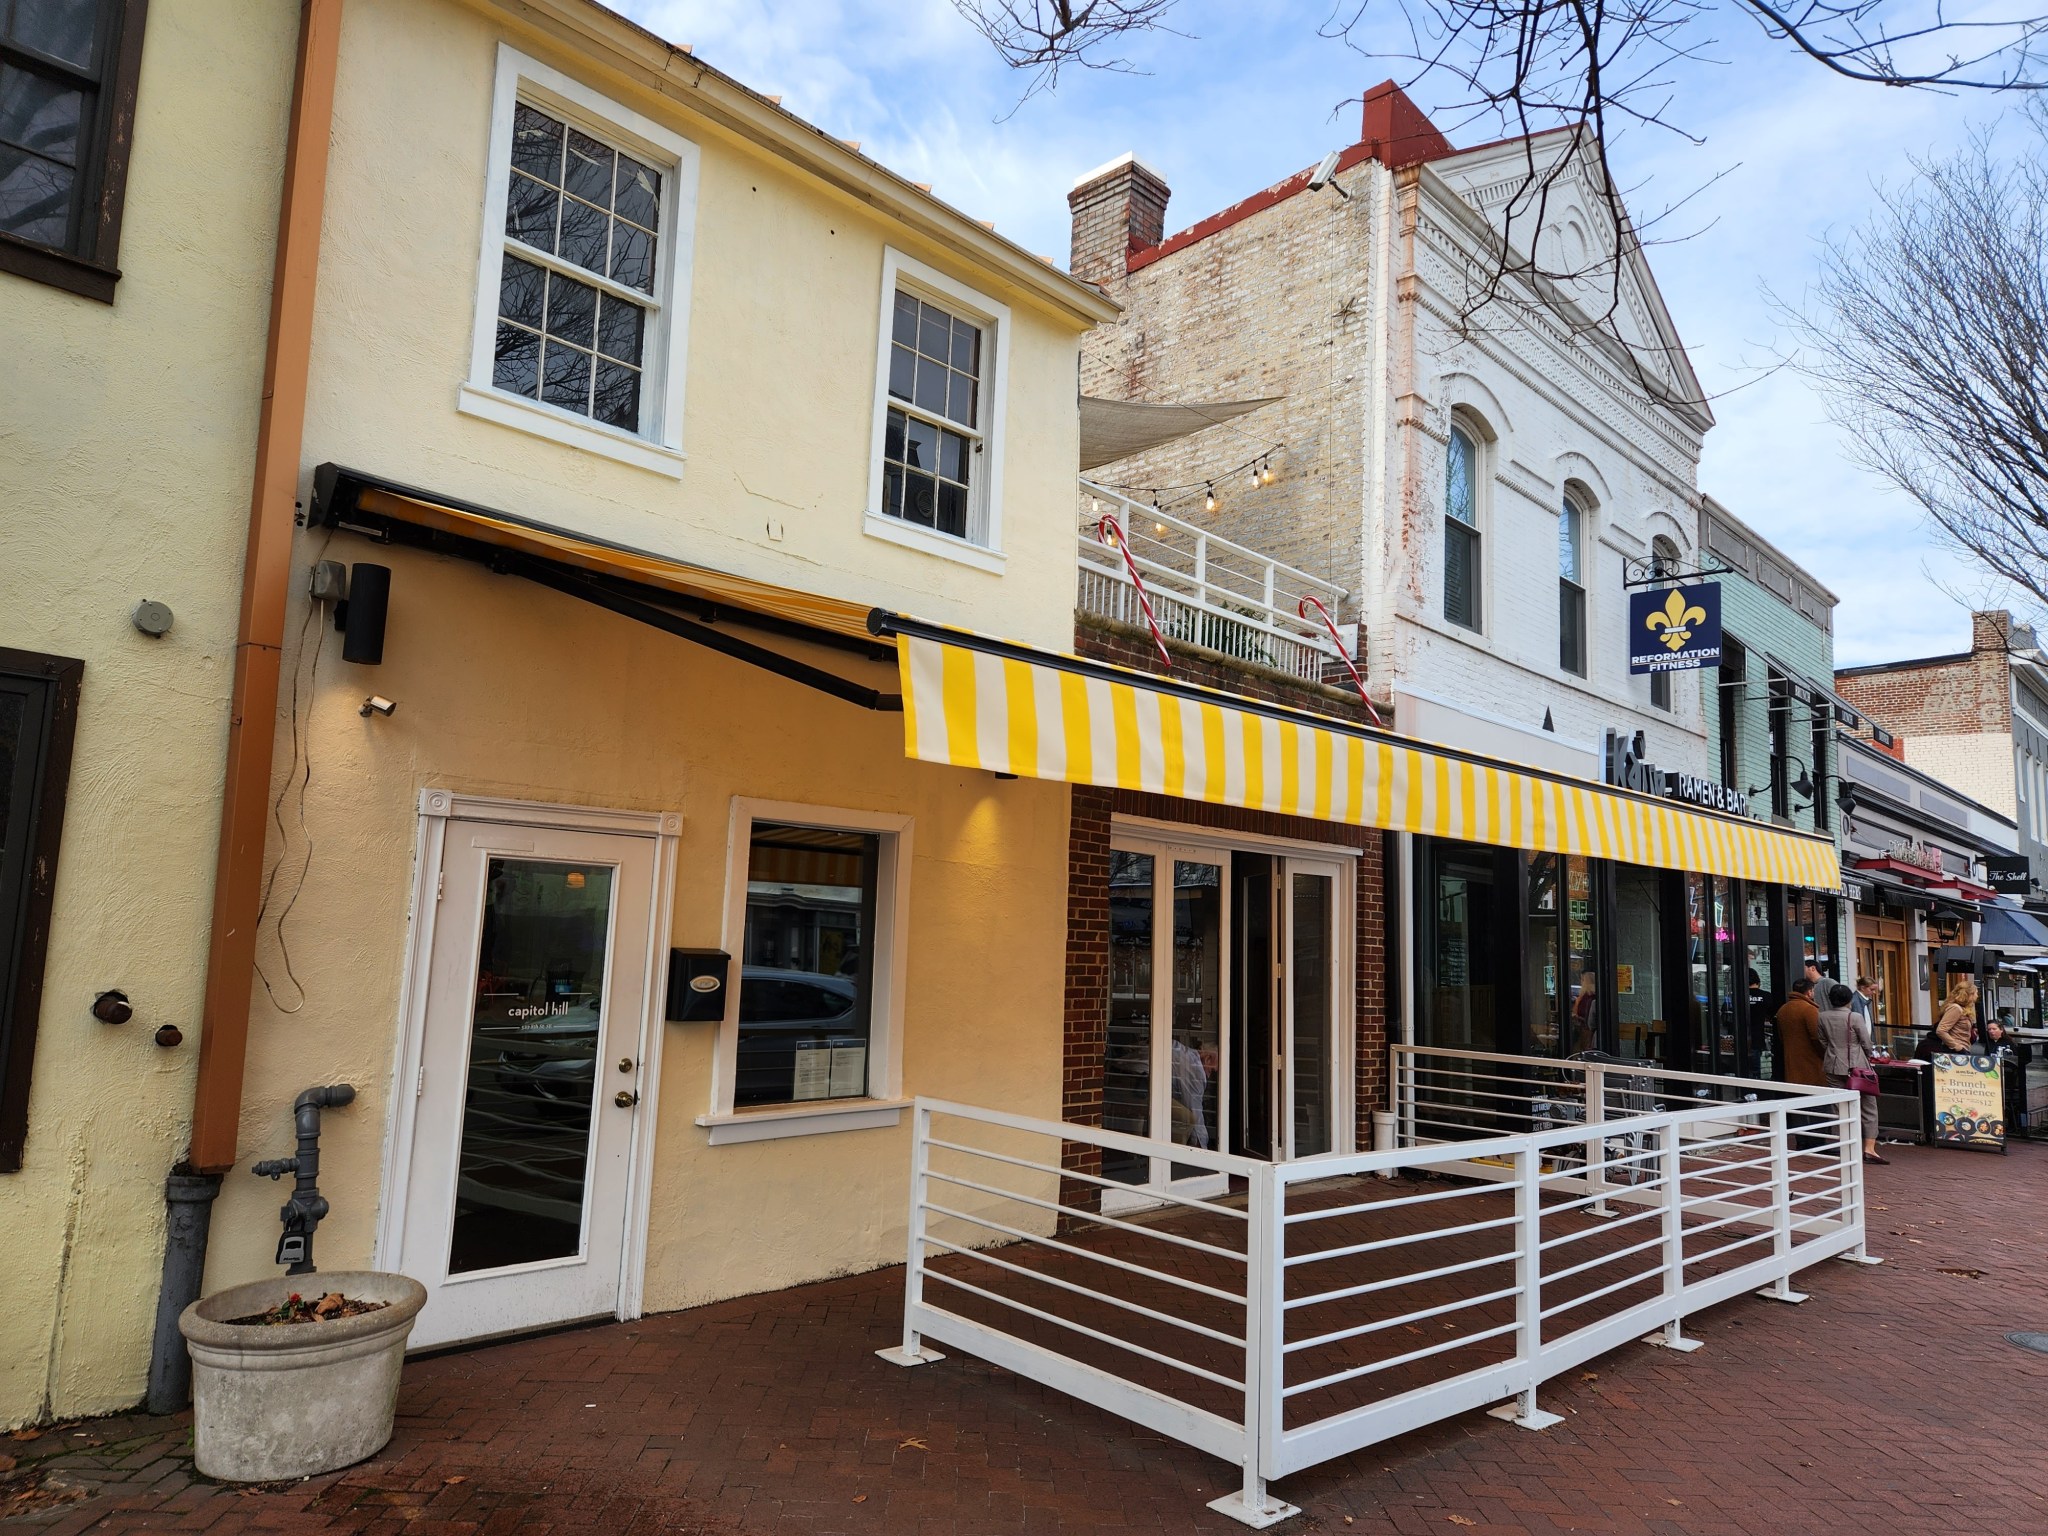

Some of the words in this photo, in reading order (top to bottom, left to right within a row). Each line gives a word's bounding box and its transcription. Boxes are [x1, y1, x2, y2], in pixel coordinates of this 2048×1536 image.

[1631, 647, 1720, 664] REFORMATION
[1649, 659, 1701, 672] FITNESS
[1679, 772, 1716, 807] RAMEN
[1717, 785, 1725, 809] &
[1726, 789, 1747, 817] BAR
[1989, 872, 2004, 881] The
[2005, 871, 2027, 882] Shell
[508, 1001, 548, 1020] capitol
[551, 1001, 569, 1015] hill
[1949, 1078, 1986, 1089] Brunch
[1941, 1085, 1996, 1098] Experience
